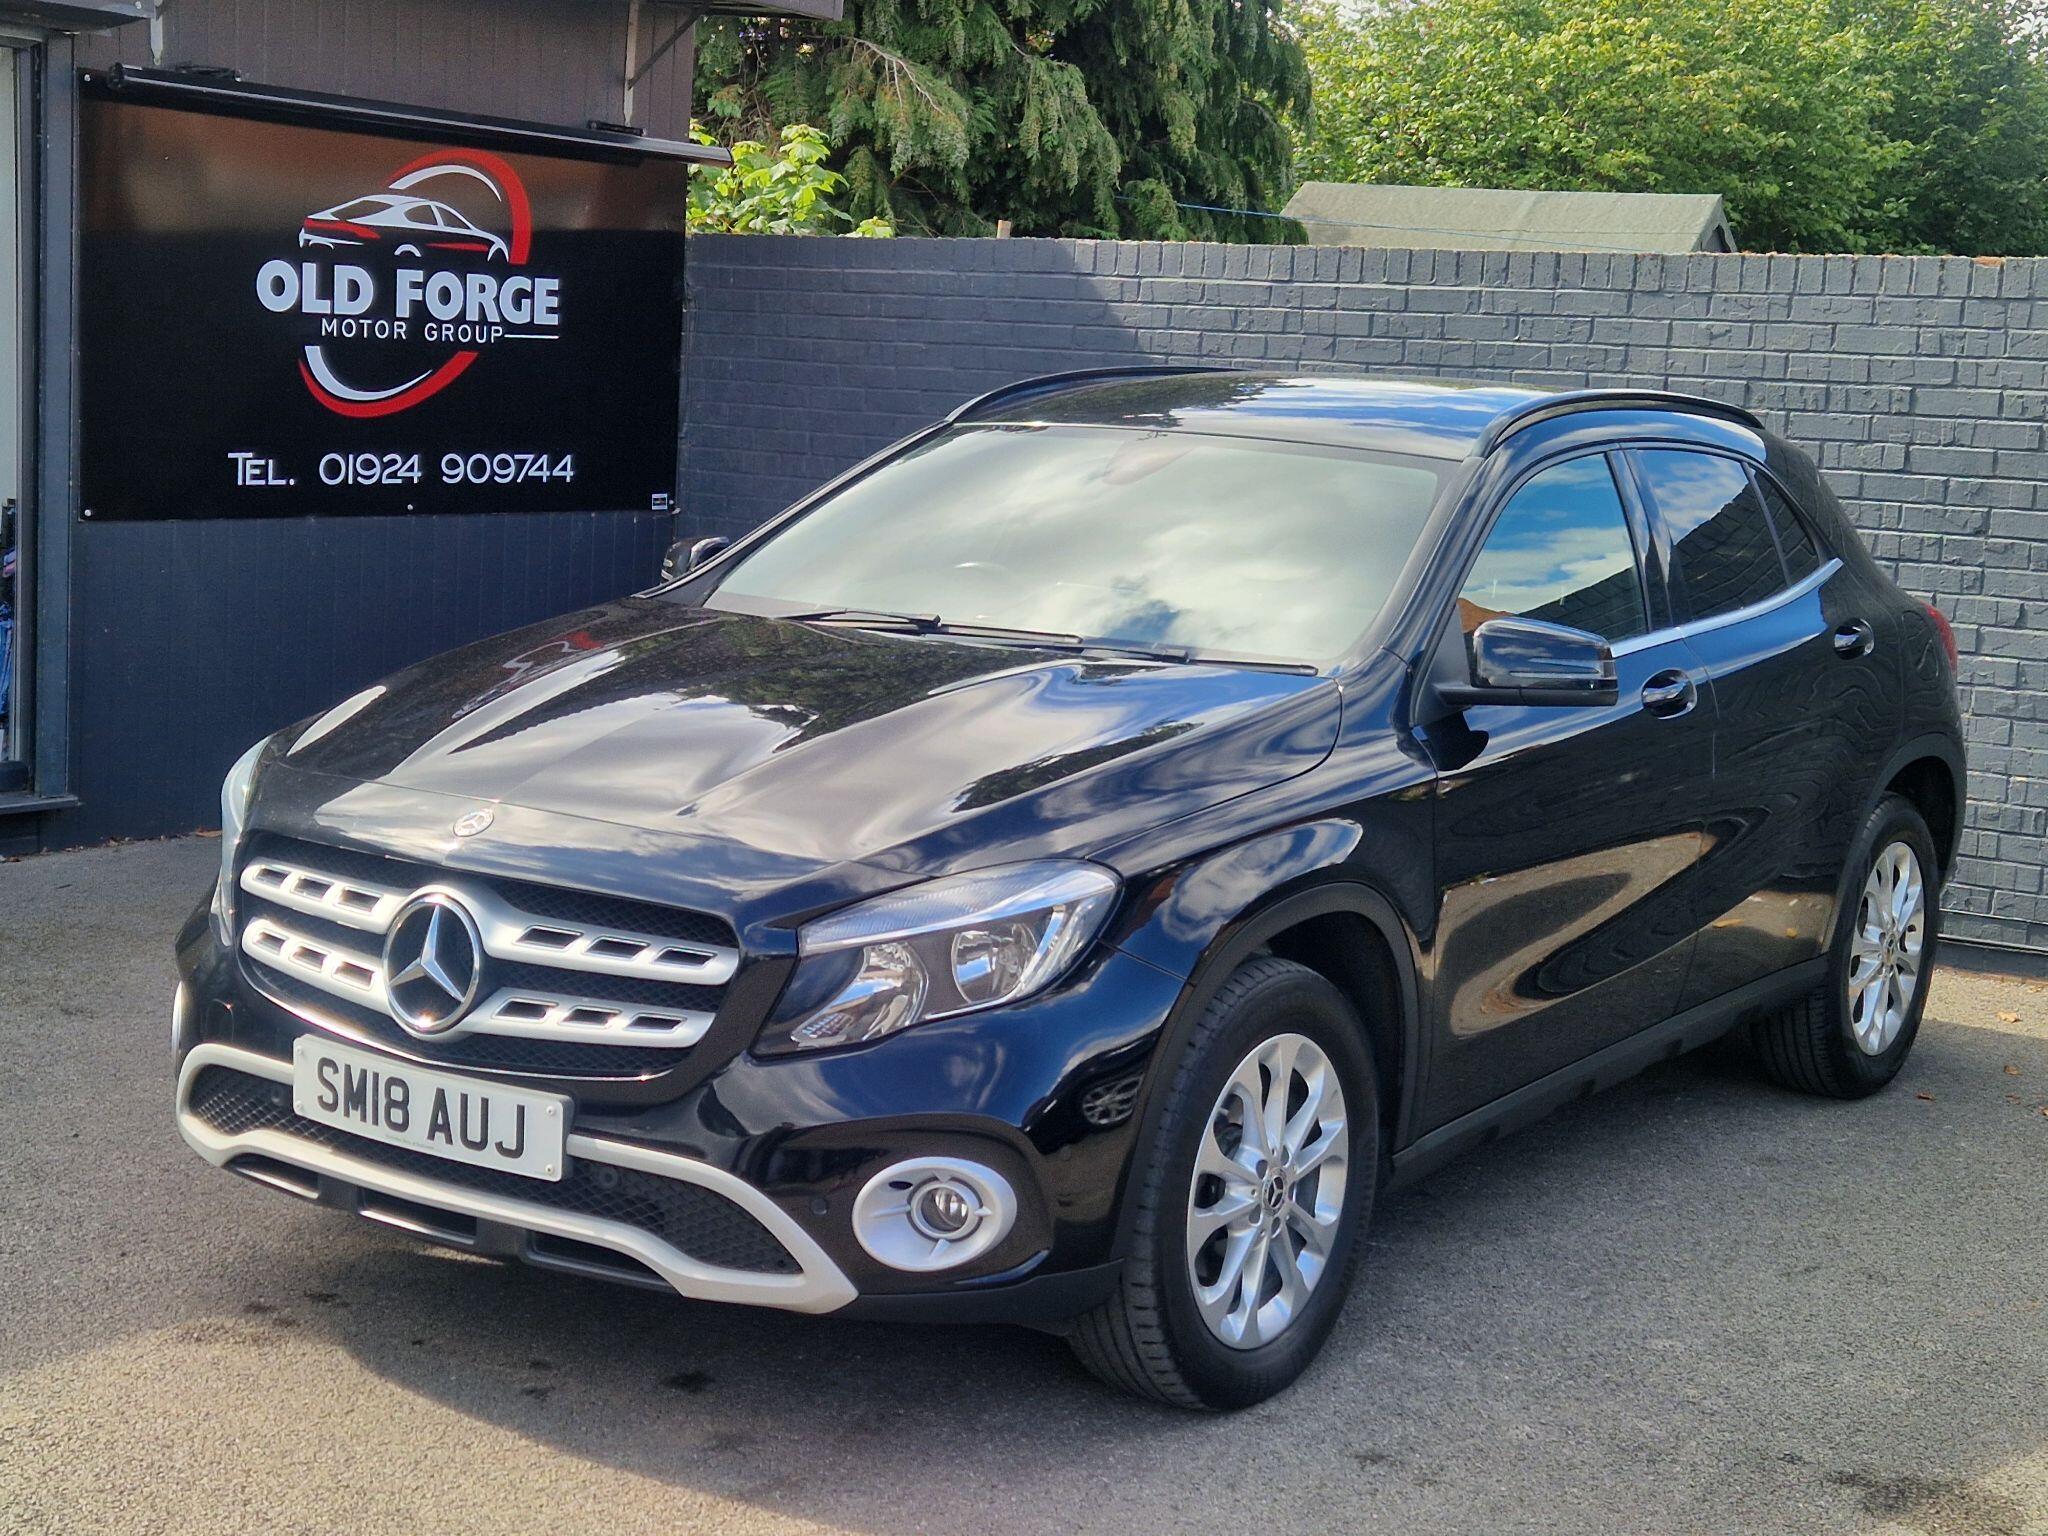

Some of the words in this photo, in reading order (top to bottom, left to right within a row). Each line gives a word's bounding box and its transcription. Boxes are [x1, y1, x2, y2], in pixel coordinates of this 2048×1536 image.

[256, 259, 374, 315] OLD
[395, 268, 559, 326] FORGE
[321, 317, 407, 340] MOTOR
[424, 323, 503, 343] GROUP
[228, 452, 295, 486] TEL.
[319, 453, 421, 485] 01924
[441, 453, 573, 485] 909744
[317, 1057, 410, 1133] SM18
[427, 1087, 525, 1159] AUJ
